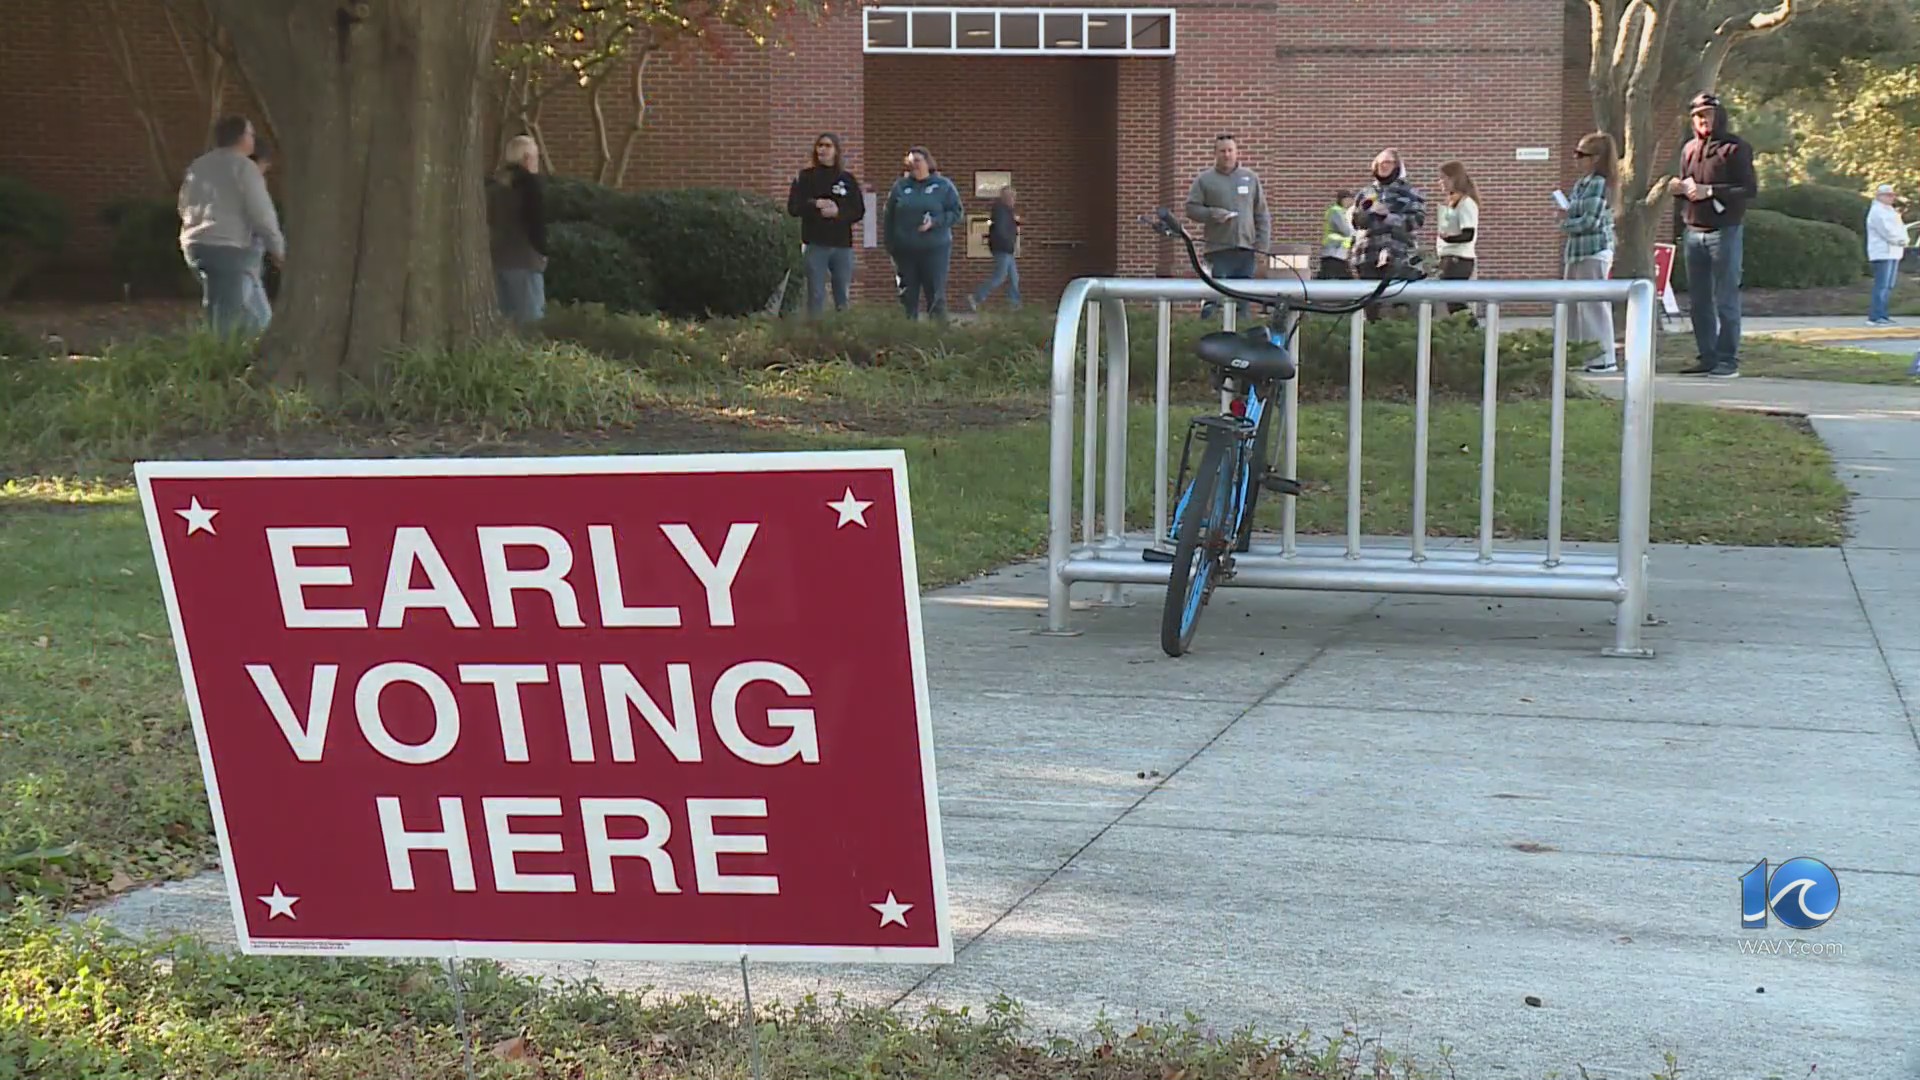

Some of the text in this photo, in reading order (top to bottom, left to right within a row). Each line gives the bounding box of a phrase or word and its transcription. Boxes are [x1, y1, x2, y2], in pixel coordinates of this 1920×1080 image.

[266, 522, 759, 629] EARLY
[245, 660, 821, 764] VOTING
[375, 797, 781, 895] HERE
